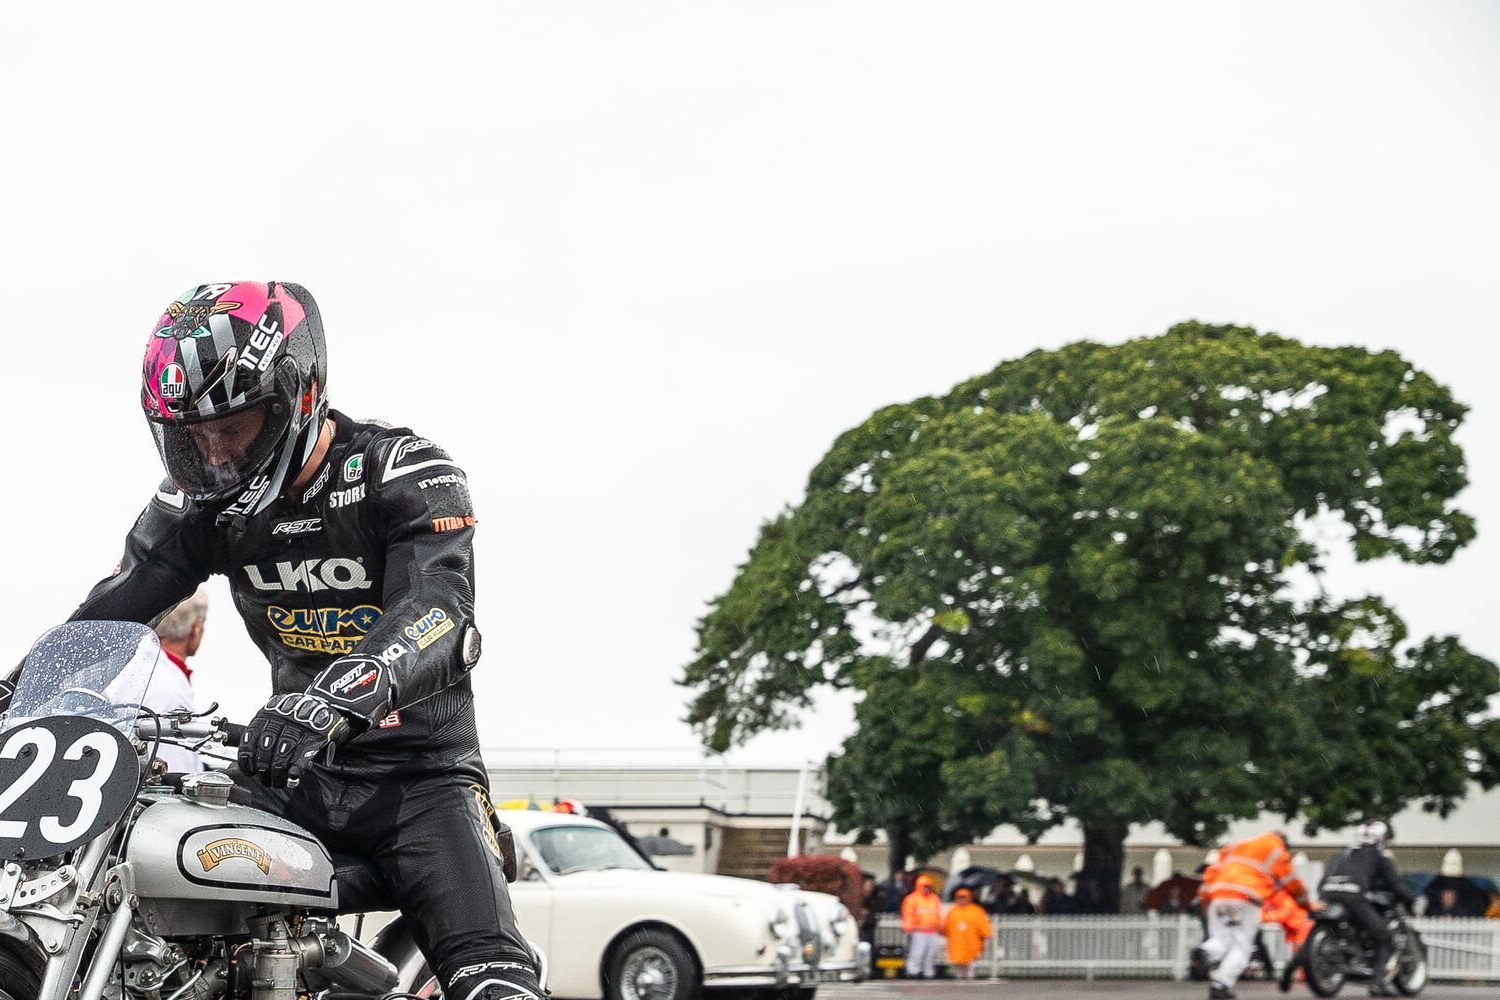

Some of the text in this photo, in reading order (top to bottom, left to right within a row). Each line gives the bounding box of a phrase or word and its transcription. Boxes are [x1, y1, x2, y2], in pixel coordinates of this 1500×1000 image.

[163, 383, 182, 397] agv
[303, 462, 330, 504] RST
[272, 518, 322, 534] RST
[243, 558, 372, 592] LKQ
[267, 605, 384, 635] euro
[404, 608, 447, 641] euro
[285, 636, 358, 651] CAR PAR
[379, 643, 407, 666] KQ
[330, 662, 365, 694] RST
[211, 843, 262, 861] VINCENT
